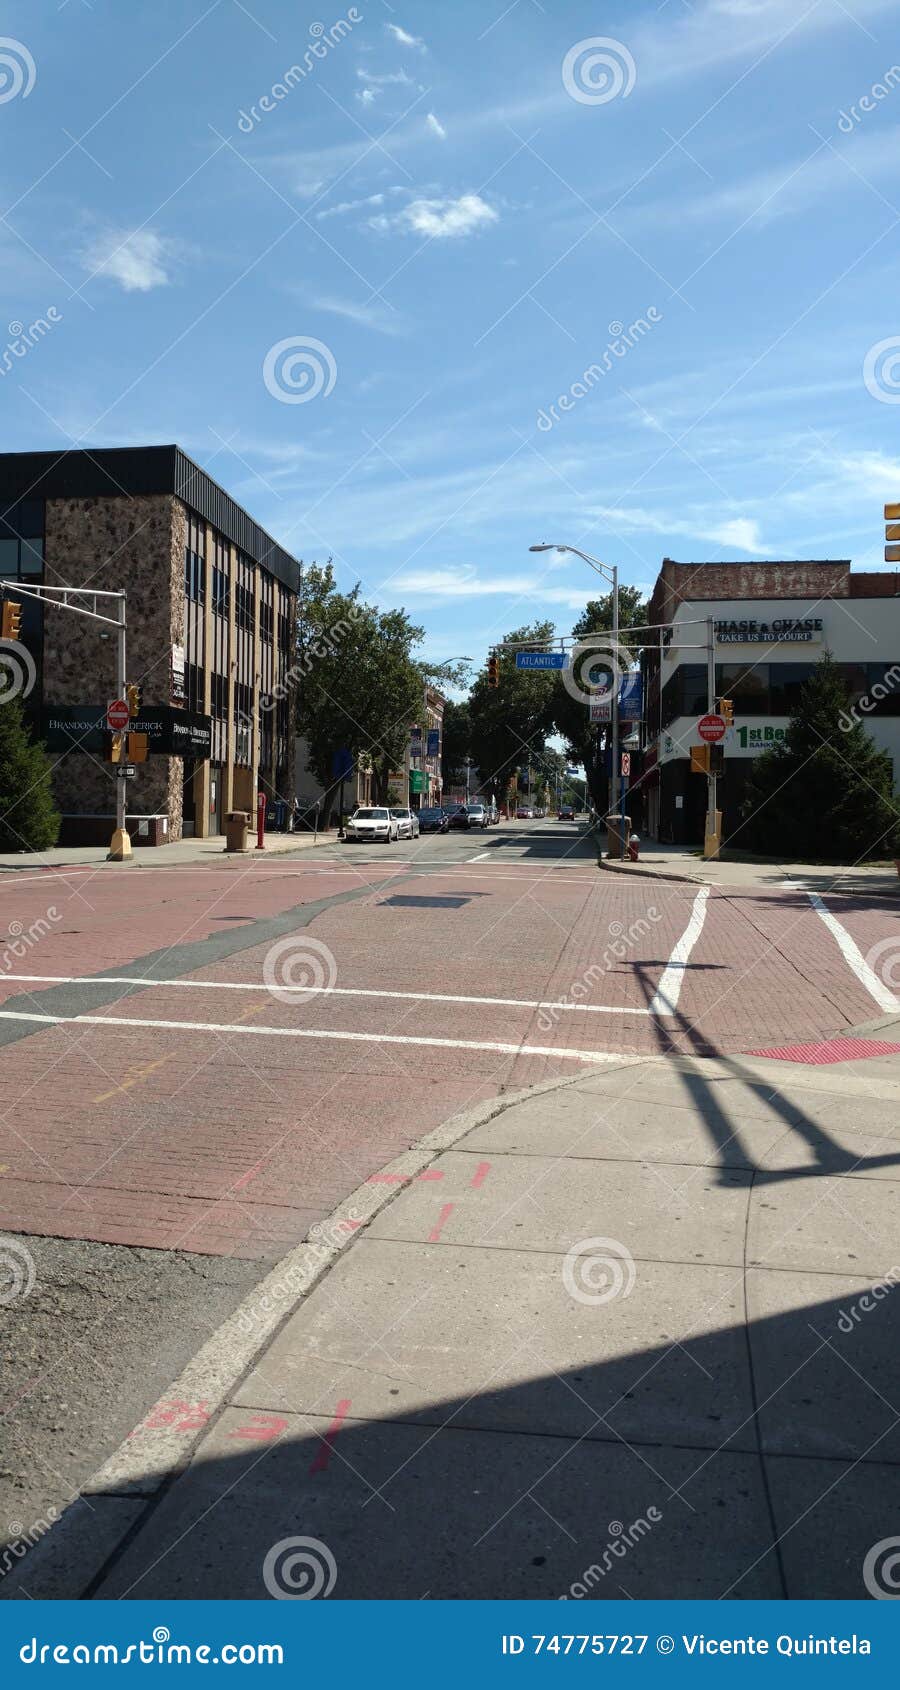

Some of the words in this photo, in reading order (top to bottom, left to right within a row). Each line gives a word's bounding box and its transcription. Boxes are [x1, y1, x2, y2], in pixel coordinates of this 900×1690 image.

[772, 619, 823, 632] CHASE
[720, 633, 744, 642] TAKE
[748, 633, 759, 641] US
[763, 633, 774, 641] TO
[777, 632, 810, 641] COURT
[521, 656, 556, 666] ATLANTIC
